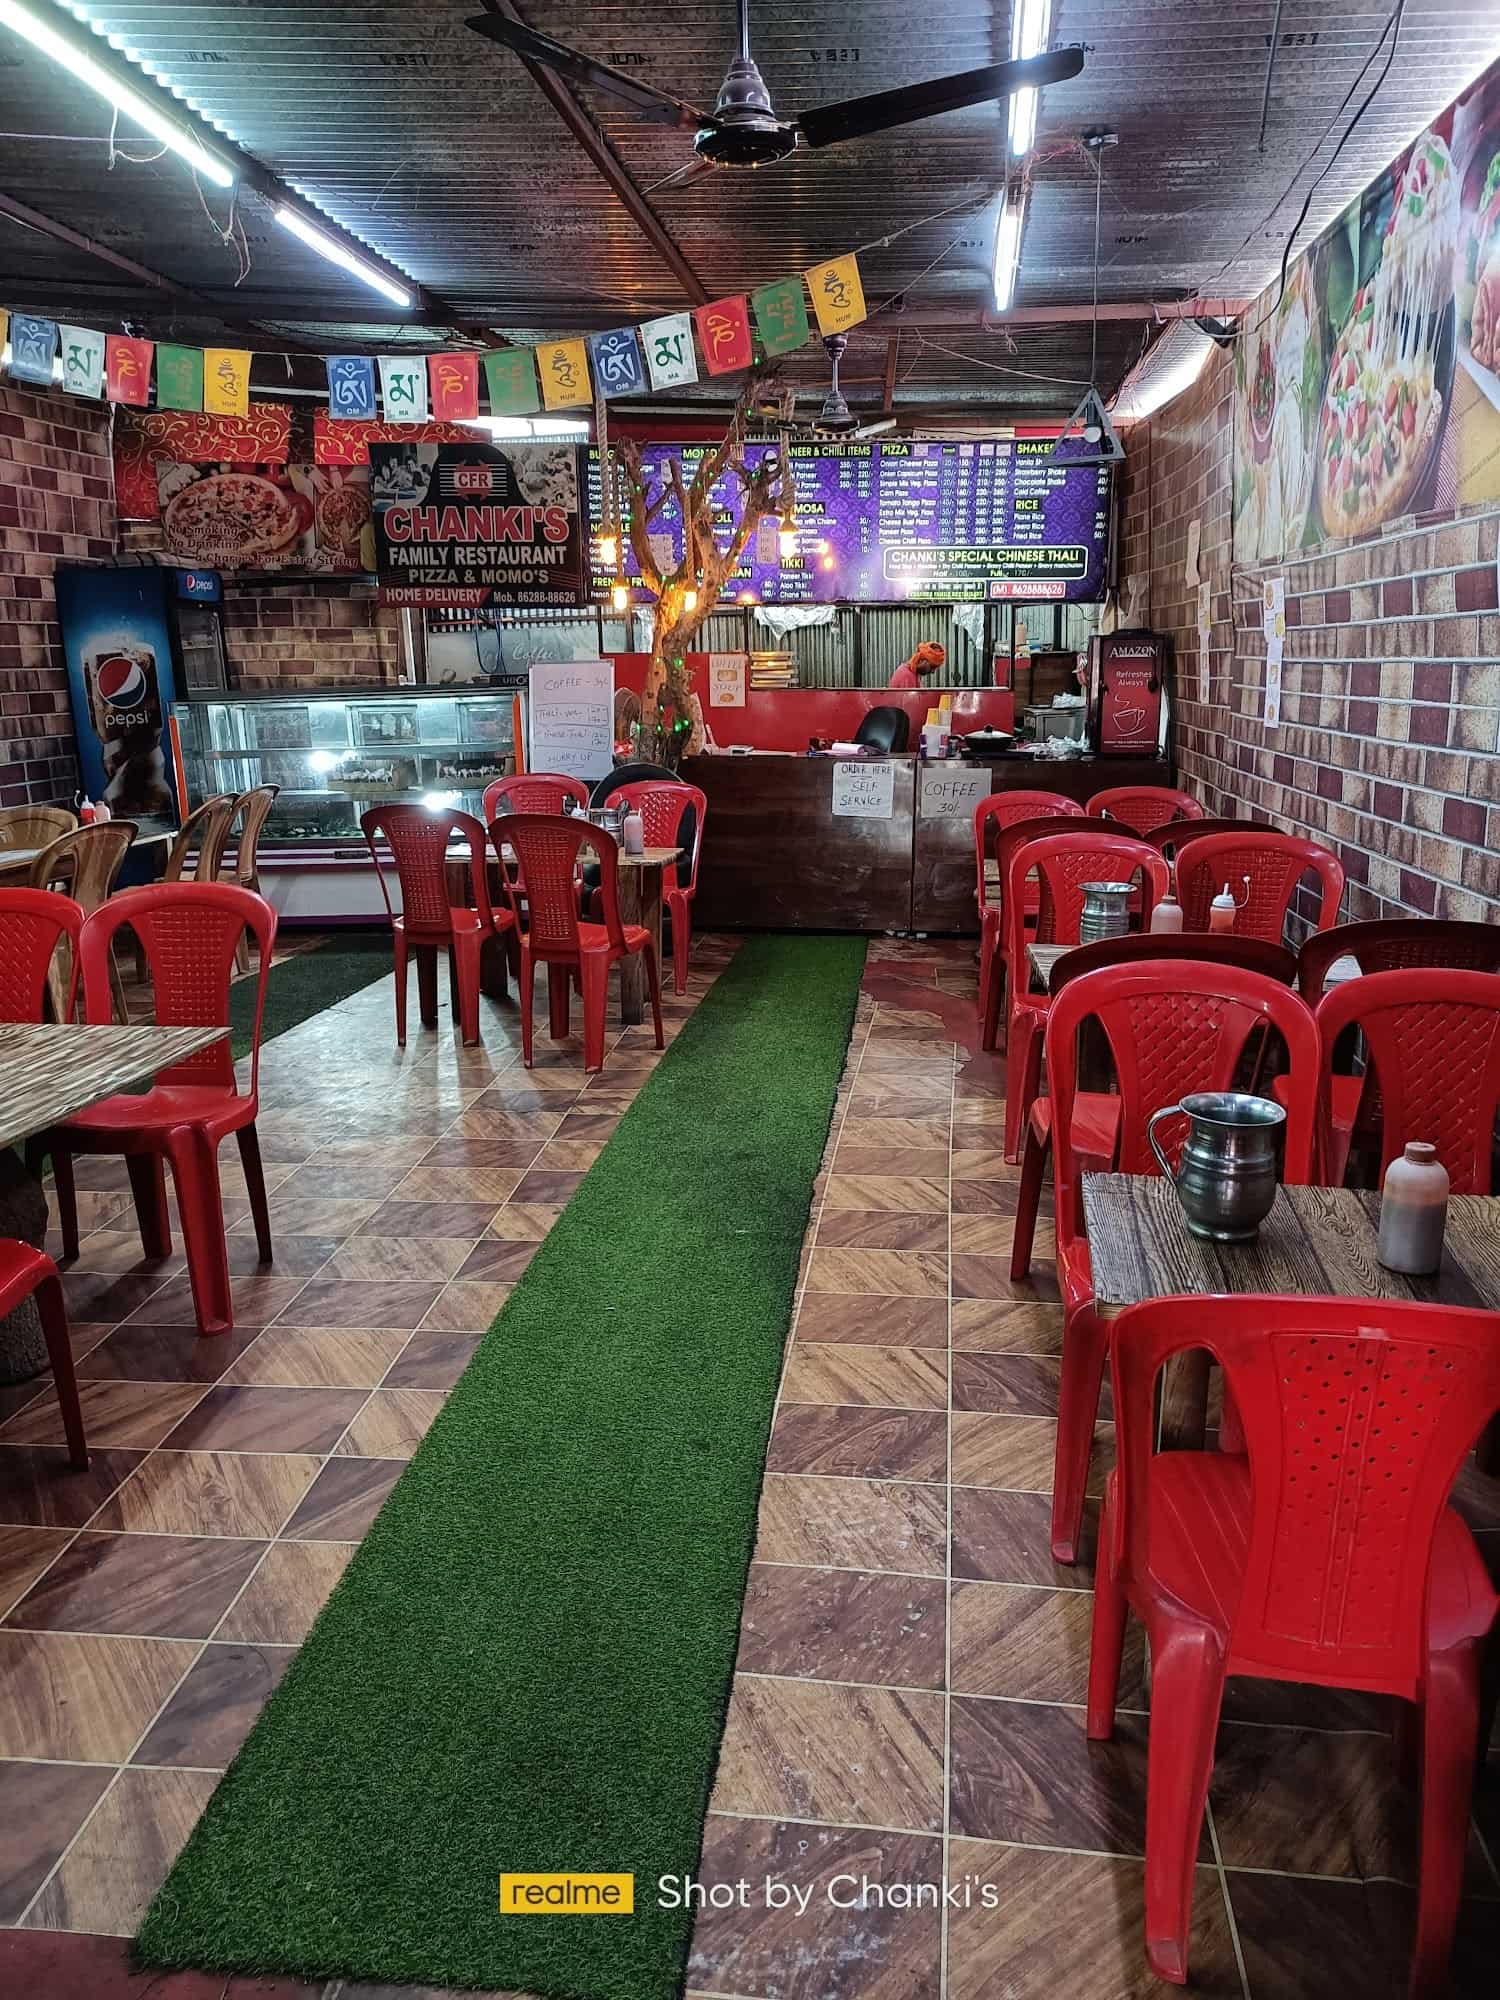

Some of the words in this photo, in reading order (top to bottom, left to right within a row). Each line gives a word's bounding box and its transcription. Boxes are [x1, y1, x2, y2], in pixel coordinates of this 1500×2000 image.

[615, 382, 631, 391] OM
[346, 407, 360, 415] OM
[848, 446, 871, 456] ITEMS
[881, 445, 909, 456] PIZZA
[458, 473, 489, 487] CFR
[1015, 500, 1039, 510] RICE
[384, 506, 570, 543] CHANKI'S
[389, 547, 449, 566] FAMILY
[455, 546, 567, 565] RESTAURANT
[891, 551, 946, 562] CHANKI'S
[948, 551, 994, 562] SPECIAL
[996, 550, 1045, 561] CHINESE
[1047, 550, 1079, 561] THALI
[781, 558, 804, 569] TIKKI
[408, 569, 459, 583] PIZZA
[464, 570, 476, 583] &
[482, 569, 549, 583] MOMO'S
[196, 579, 214, 590] pepsi
[386, 588, 421, 602] HOME
[425, 588, 482, 602] DELIVERY
[493, 591, 516, 604] Mob.
[1109, 646, 1159, 658] AMAZON
[1118, 680, 1144, 688] Always
[105, 710, 149, 728] pepsi
[873, 765, 892, 775] HERE
[851, 781, 877, 793] SELF
[925, 781, 978, 798] COFFEE
[840, 795, 882, 806] SERVICE
